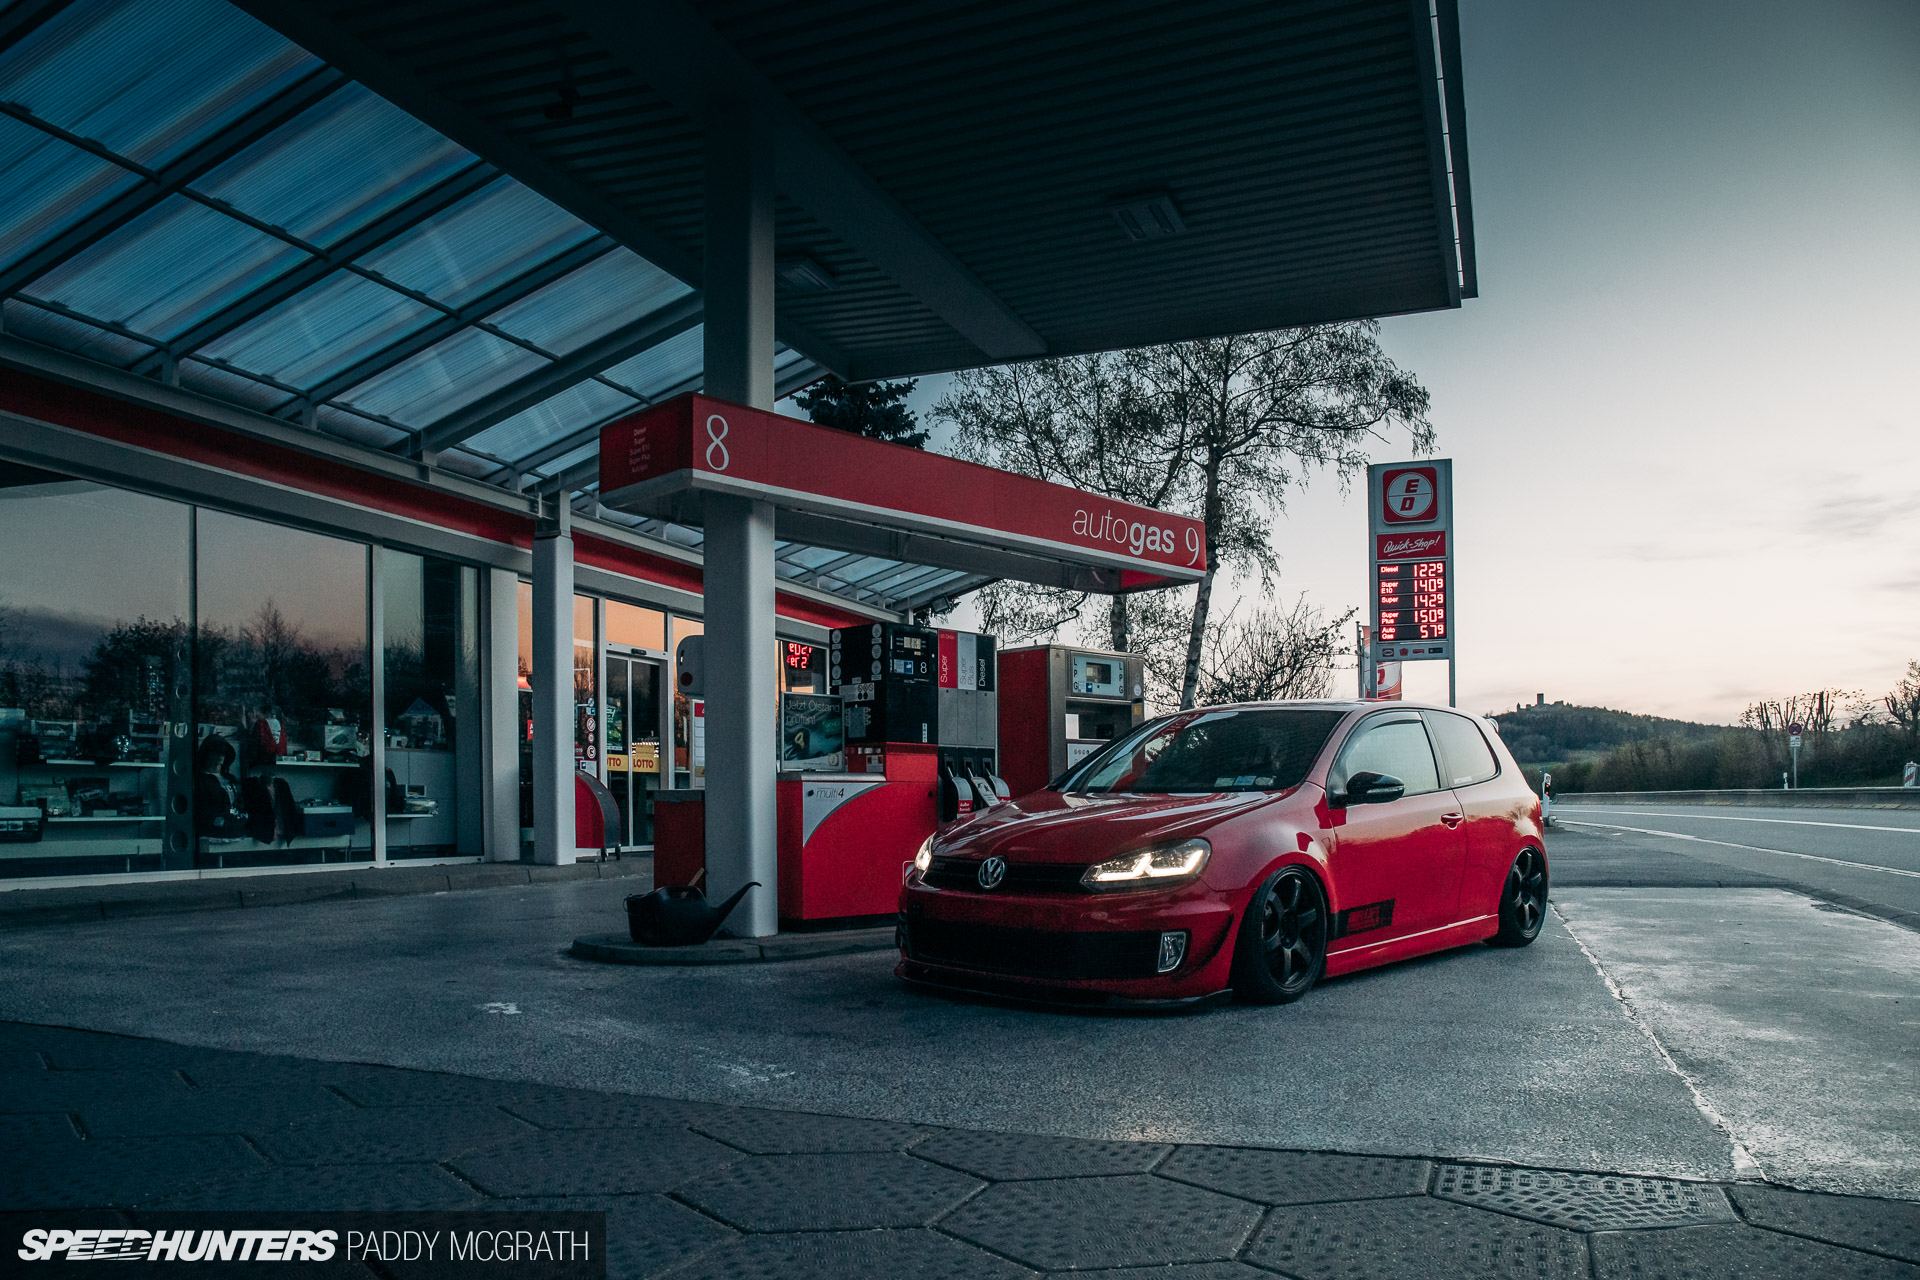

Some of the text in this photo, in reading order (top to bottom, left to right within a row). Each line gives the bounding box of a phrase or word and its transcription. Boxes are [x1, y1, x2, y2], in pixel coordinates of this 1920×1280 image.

[706, 414, 730, 471] 8
[1072, 509, 1175, 556] autogas
[1185, 527, 1200, 566] 9
[1383, 534, 1441, 553] Quick-Shop!
[1380, 562, 1444, 577] Diesel 1229
[1413, 578, 1444, 592] 1409
[1414, 593, 1444, 607] 1429
[1414, 609, 1444, 623] 1509
[1420, 624, 1444, 639] 579
[920, 661, 928, 674] 8
[940, 654, 949, 683] Super
[978, 658, 986, 687] Diesel
[967, 665, 975, 686] Plus
[785, 700, 806, 711] Jetzt
[607, 757, 622, 767] TTO
[633, 759, 654, 769] LOTTO
